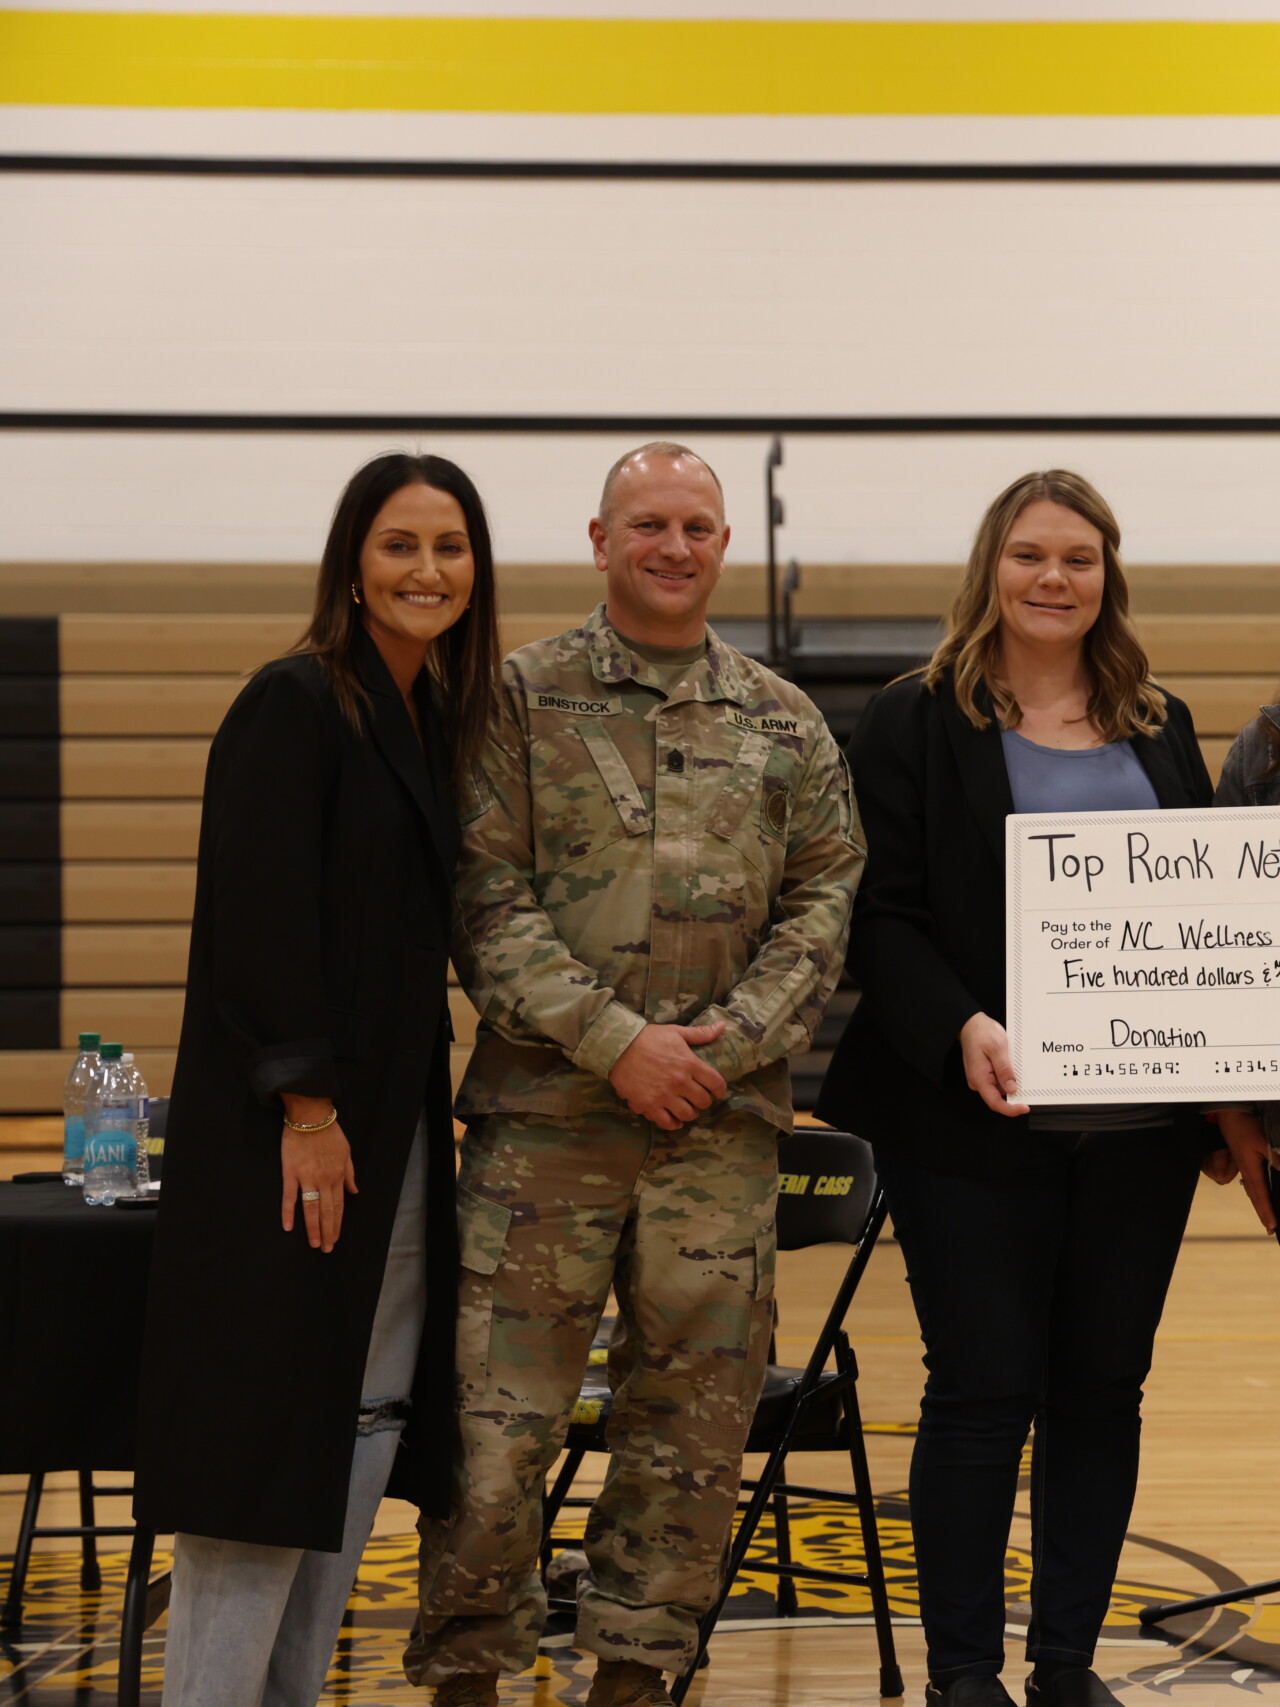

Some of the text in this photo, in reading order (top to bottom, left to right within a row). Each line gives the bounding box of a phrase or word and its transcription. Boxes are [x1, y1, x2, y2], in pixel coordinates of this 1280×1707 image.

[538, 695, 611, 713] BINSTOCK
[761, 718, 798, 733] ARMY
[1027, 833, 1104, 893] Top
[1127, 832, 1214, 884] Rank
[1041, 919, 1112, 936] Pay to the
[1120, 920, 1164, 951] NC
[1178, 918, 1273, 951] Wellness
[1050, 936, 1110, 950] Order of
[1063, 958, 1105, 989] Five
[1112, 964, 1189, 988] hundred
[1196, 966, 1255, 987] dollars
[1110, 1018, 1207, 1048] Donation
[1042, 1041, 1084, 1053] Memo
[813, 1175, 854, 1195] CASS
